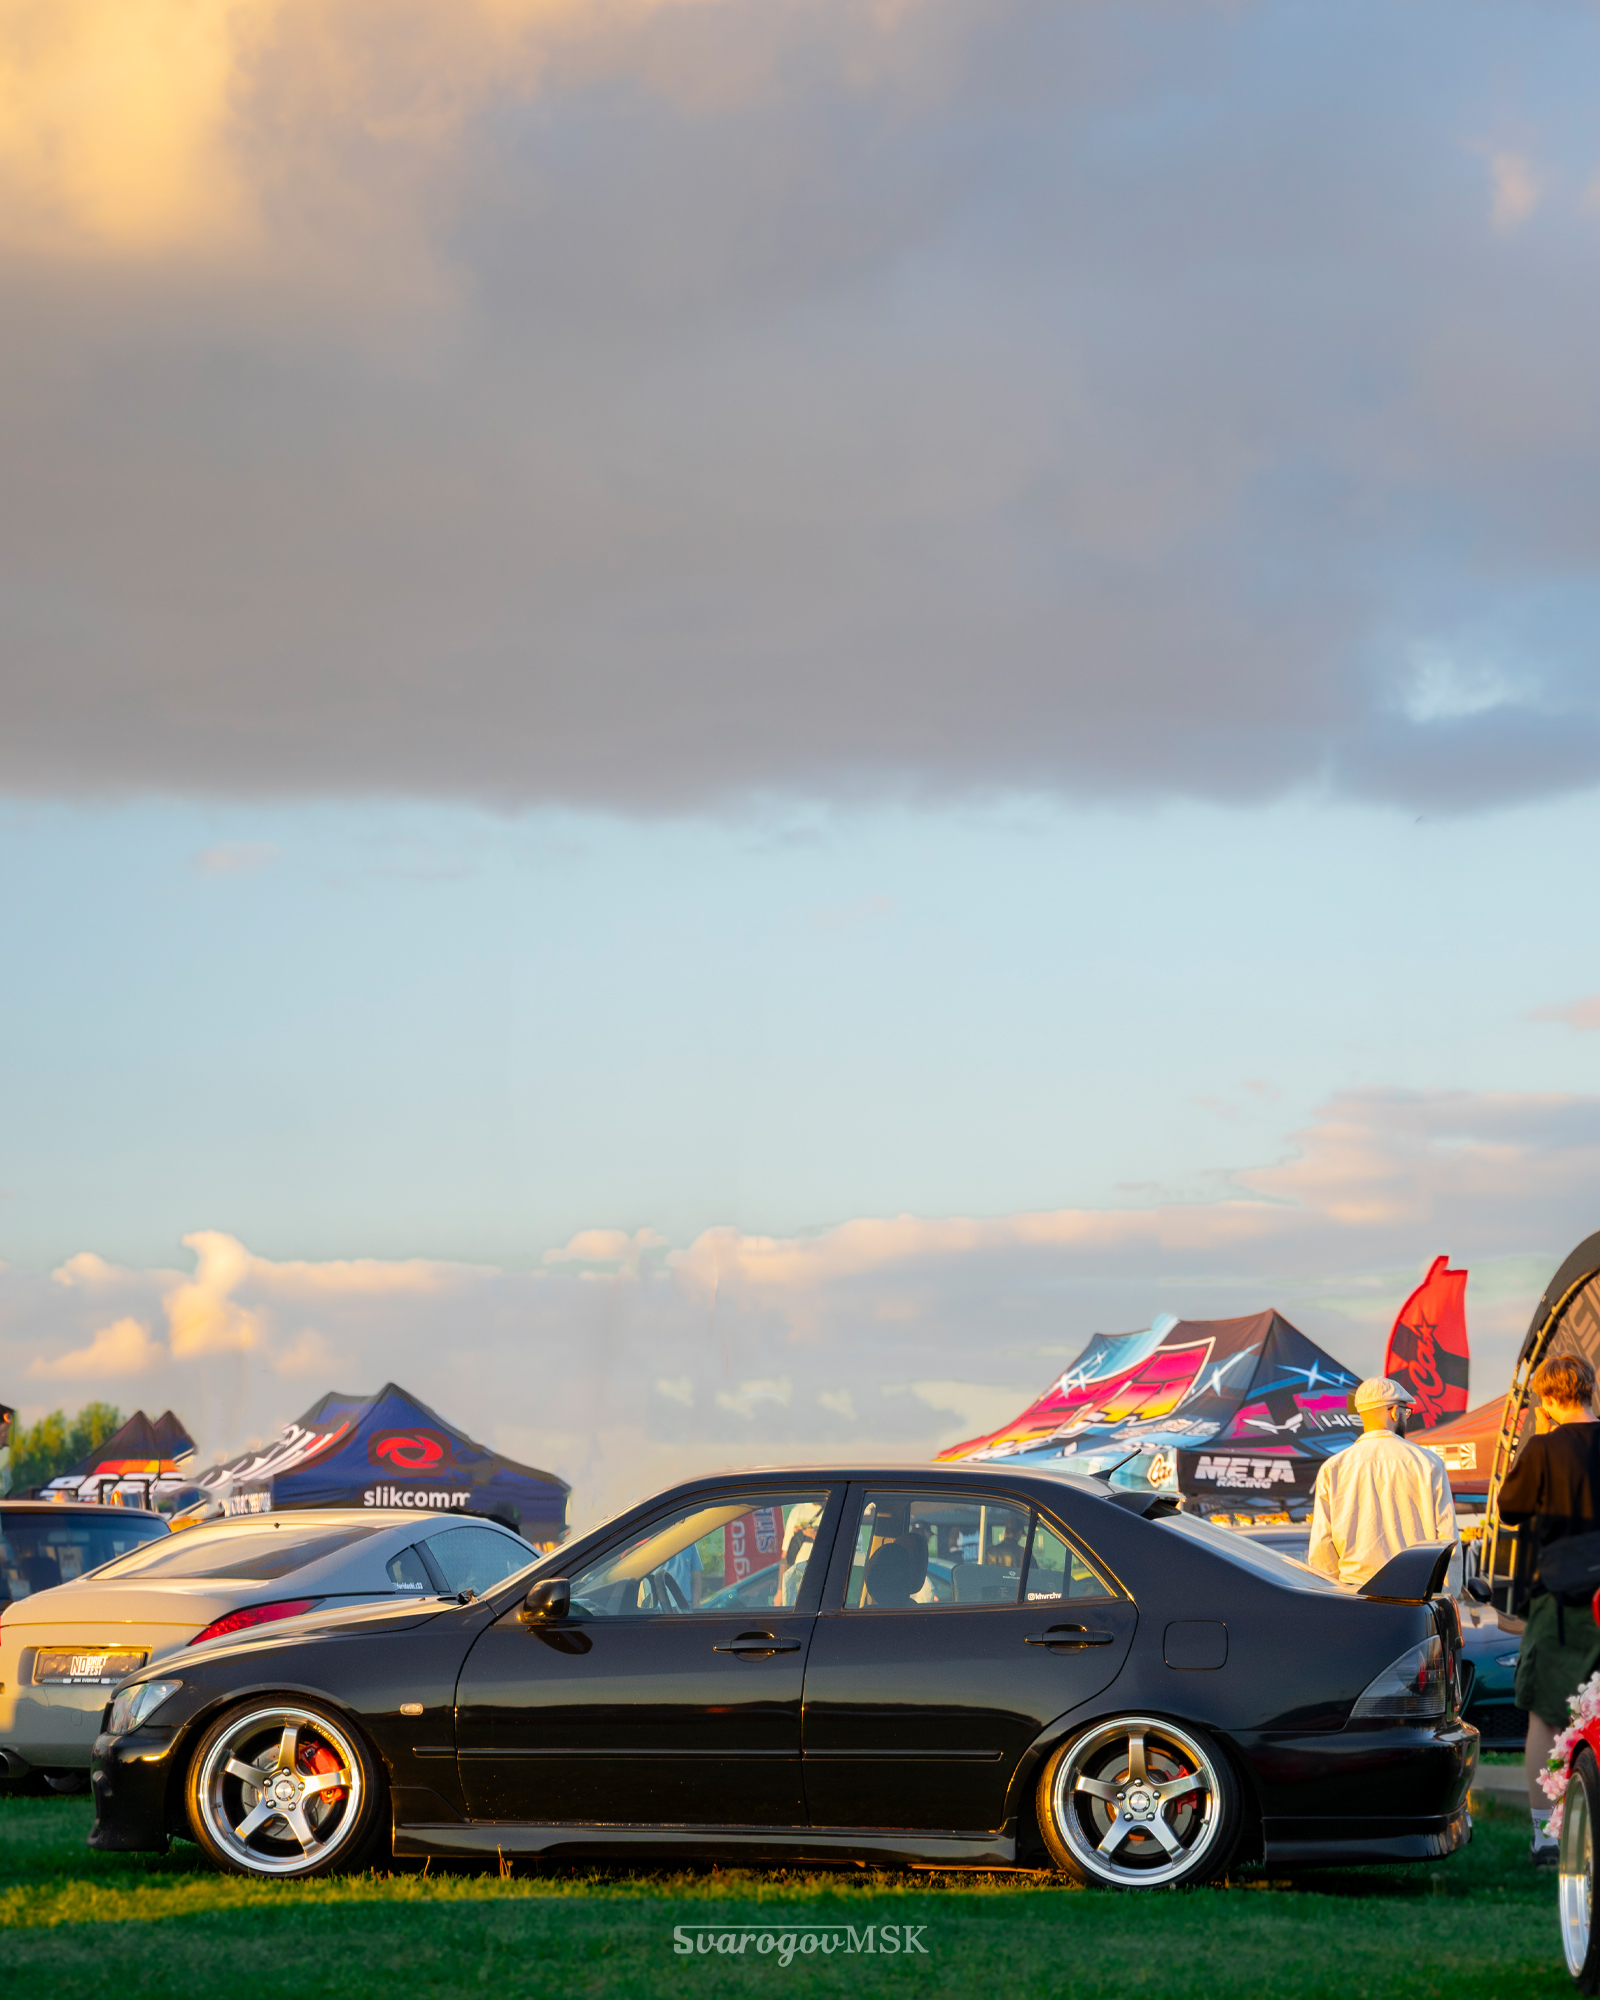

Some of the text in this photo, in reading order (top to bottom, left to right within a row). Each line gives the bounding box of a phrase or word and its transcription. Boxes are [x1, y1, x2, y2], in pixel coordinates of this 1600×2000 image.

[1195, 1456, 1296, 1483] META
[1216, 1476, 1272, 1489] RACING
[86, 1666, 103, 1676] FEST
